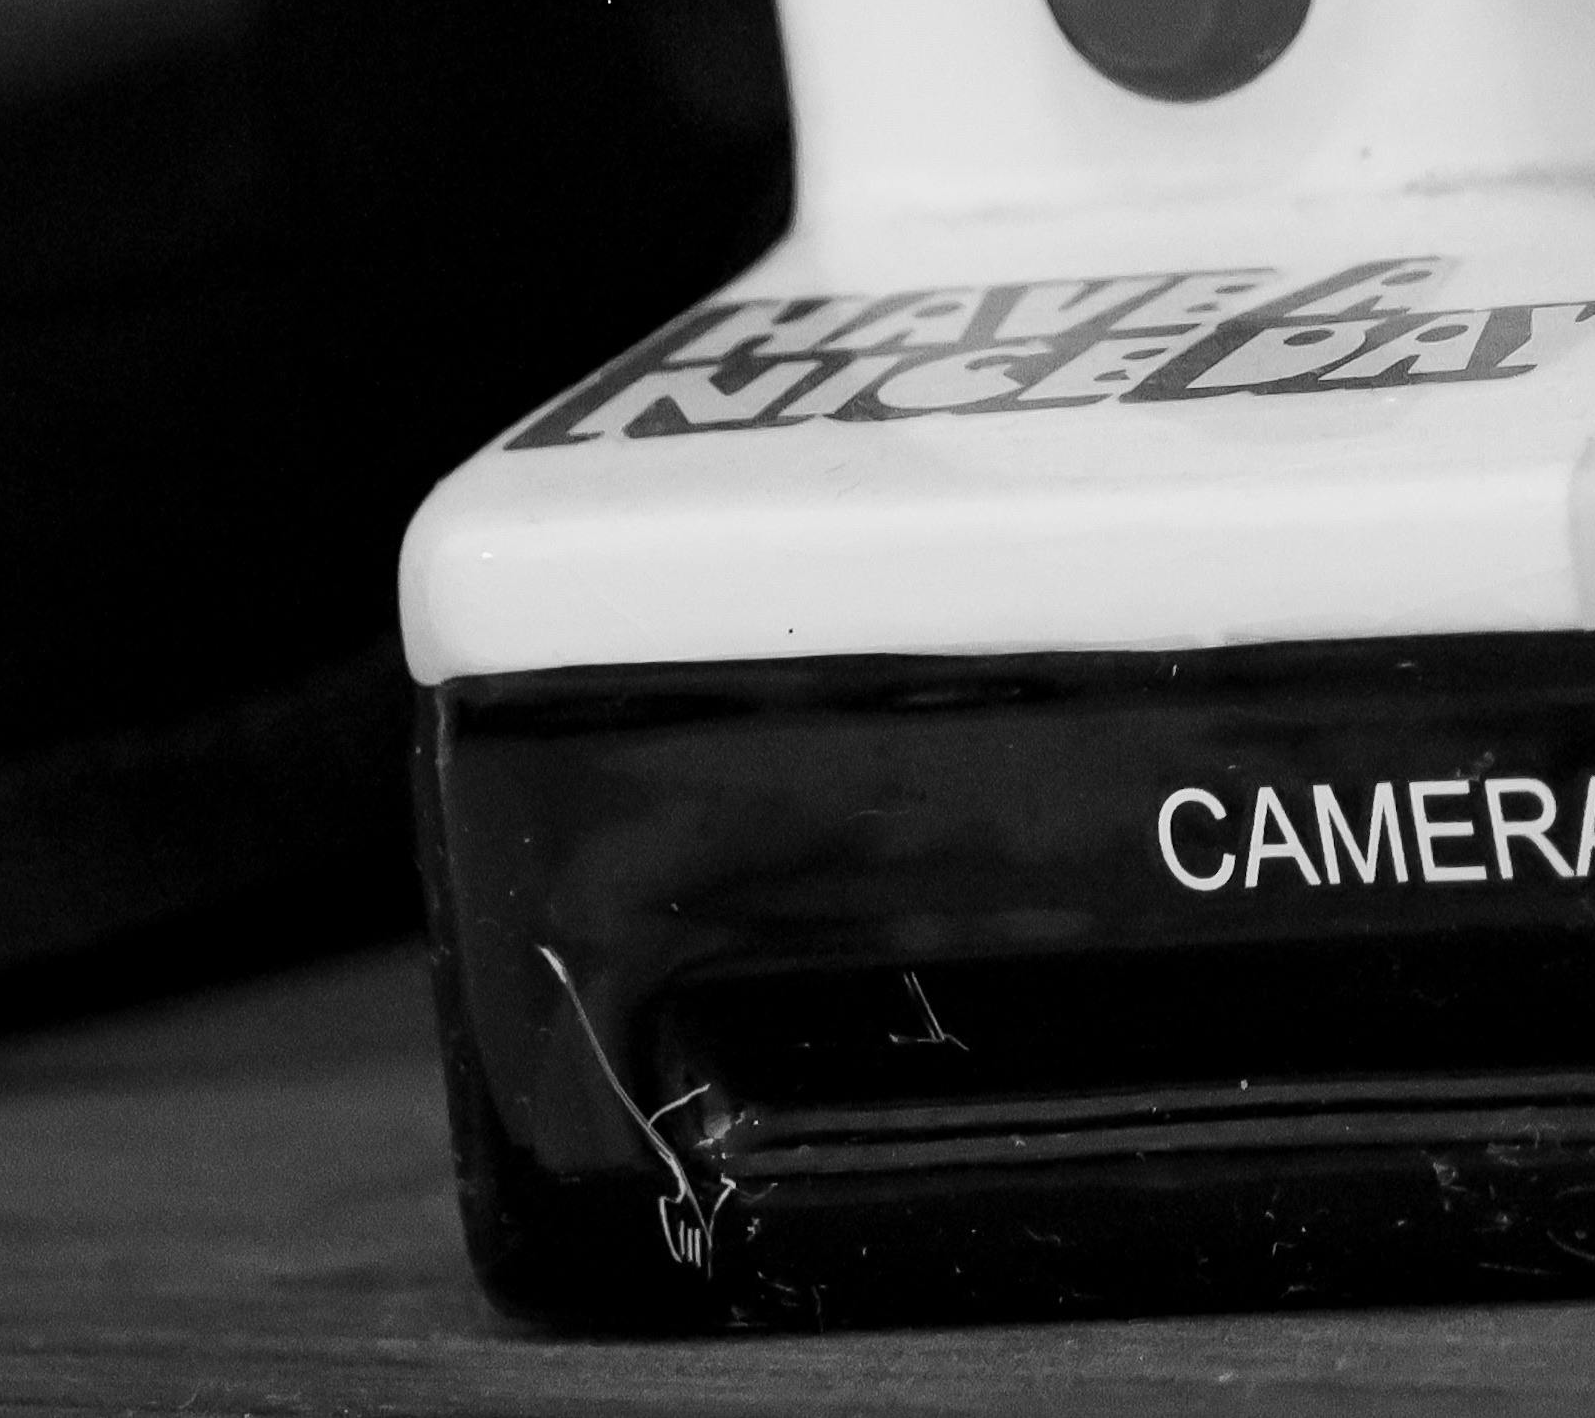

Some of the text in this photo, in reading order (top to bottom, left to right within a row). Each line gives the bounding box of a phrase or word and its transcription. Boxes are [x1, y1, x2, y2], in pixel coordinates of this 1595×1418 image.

[653, 253, 1455, 369] HAVE A
[523, 322, 1205, 449] NICE
